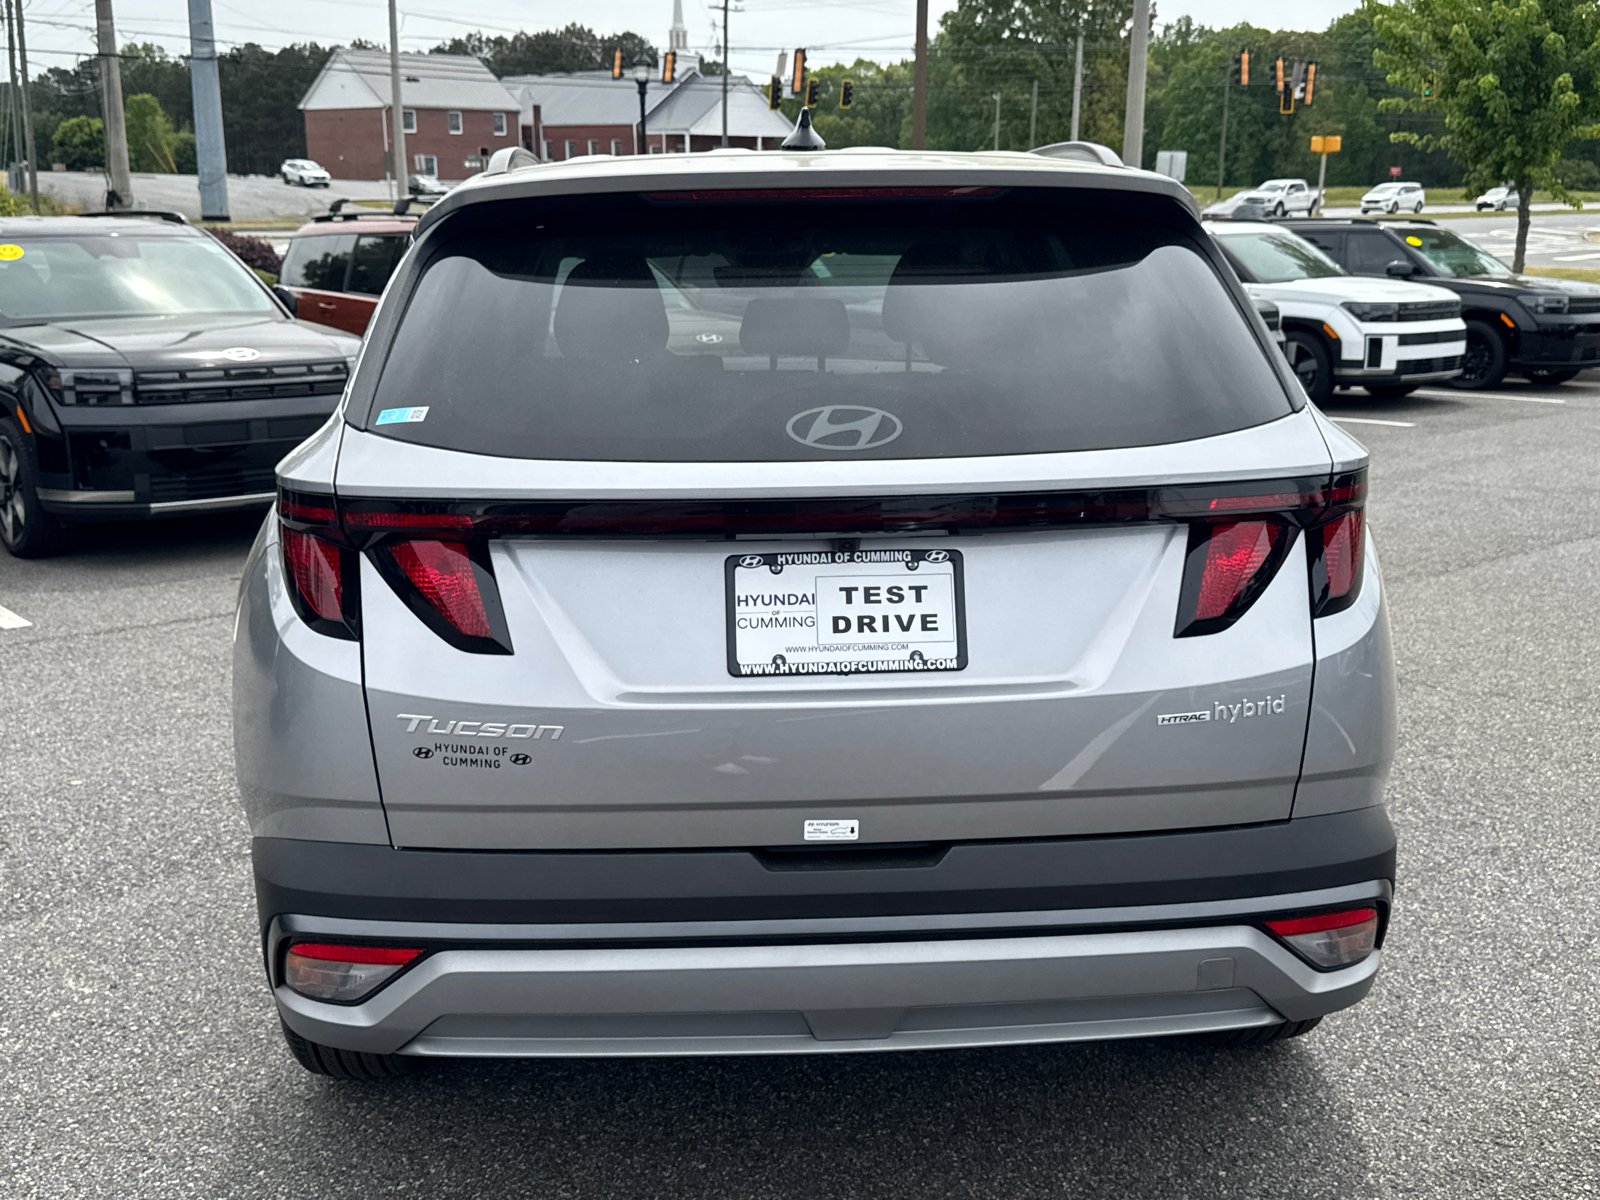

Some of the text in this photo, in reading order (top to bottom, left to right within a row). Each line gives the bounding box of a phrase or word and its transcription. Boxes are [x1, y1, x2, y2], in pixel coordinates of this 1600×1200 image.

[777, 550, 912, 565] HYUNDAI OF CUMMING
[736, 593, 816, 607] HYUNDAI
[838, 585, 928, 604] TEST
[736, 615, 816, 630] CUMMING
[832, 613, 939, 634] DRIVE
[785, 643, 909, 654] WWW.HYUNDAIOFCUMMING.COM
[1160, 694, 1286, 724] HTRAC hybrid
[434, 743, 508, 756] HYUNDAI OF
[442, 756, 501, 769] CUMMING
